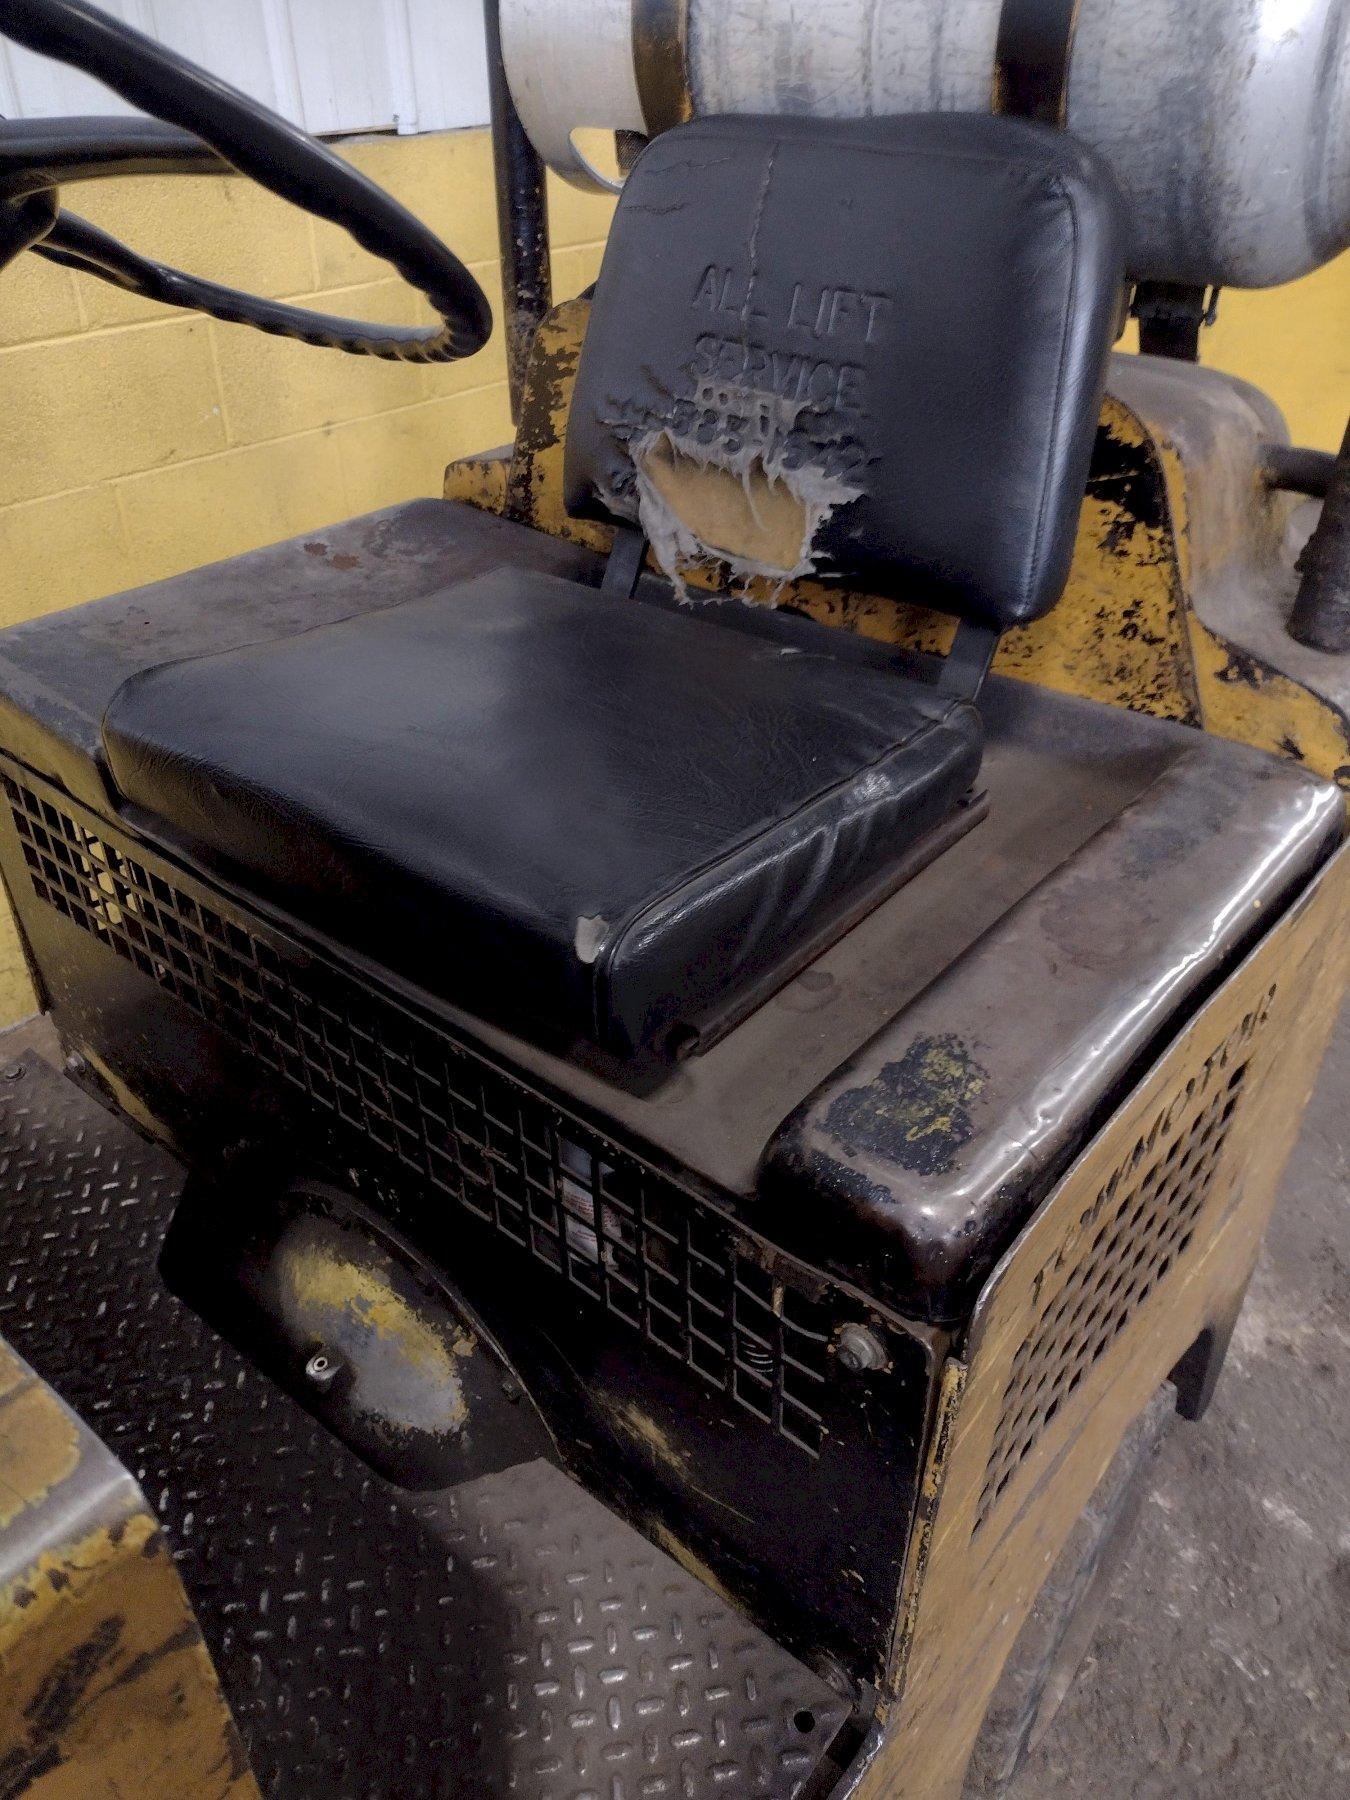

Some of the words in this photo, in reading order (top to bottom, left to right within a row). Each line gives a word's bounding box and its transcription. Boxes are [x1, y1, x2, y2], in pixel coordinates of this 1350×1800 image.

[692, 263, 768, 319] ALL
[786, 282, 894, 343] LIFT
[690, 331, 867, 409] SERVICE
